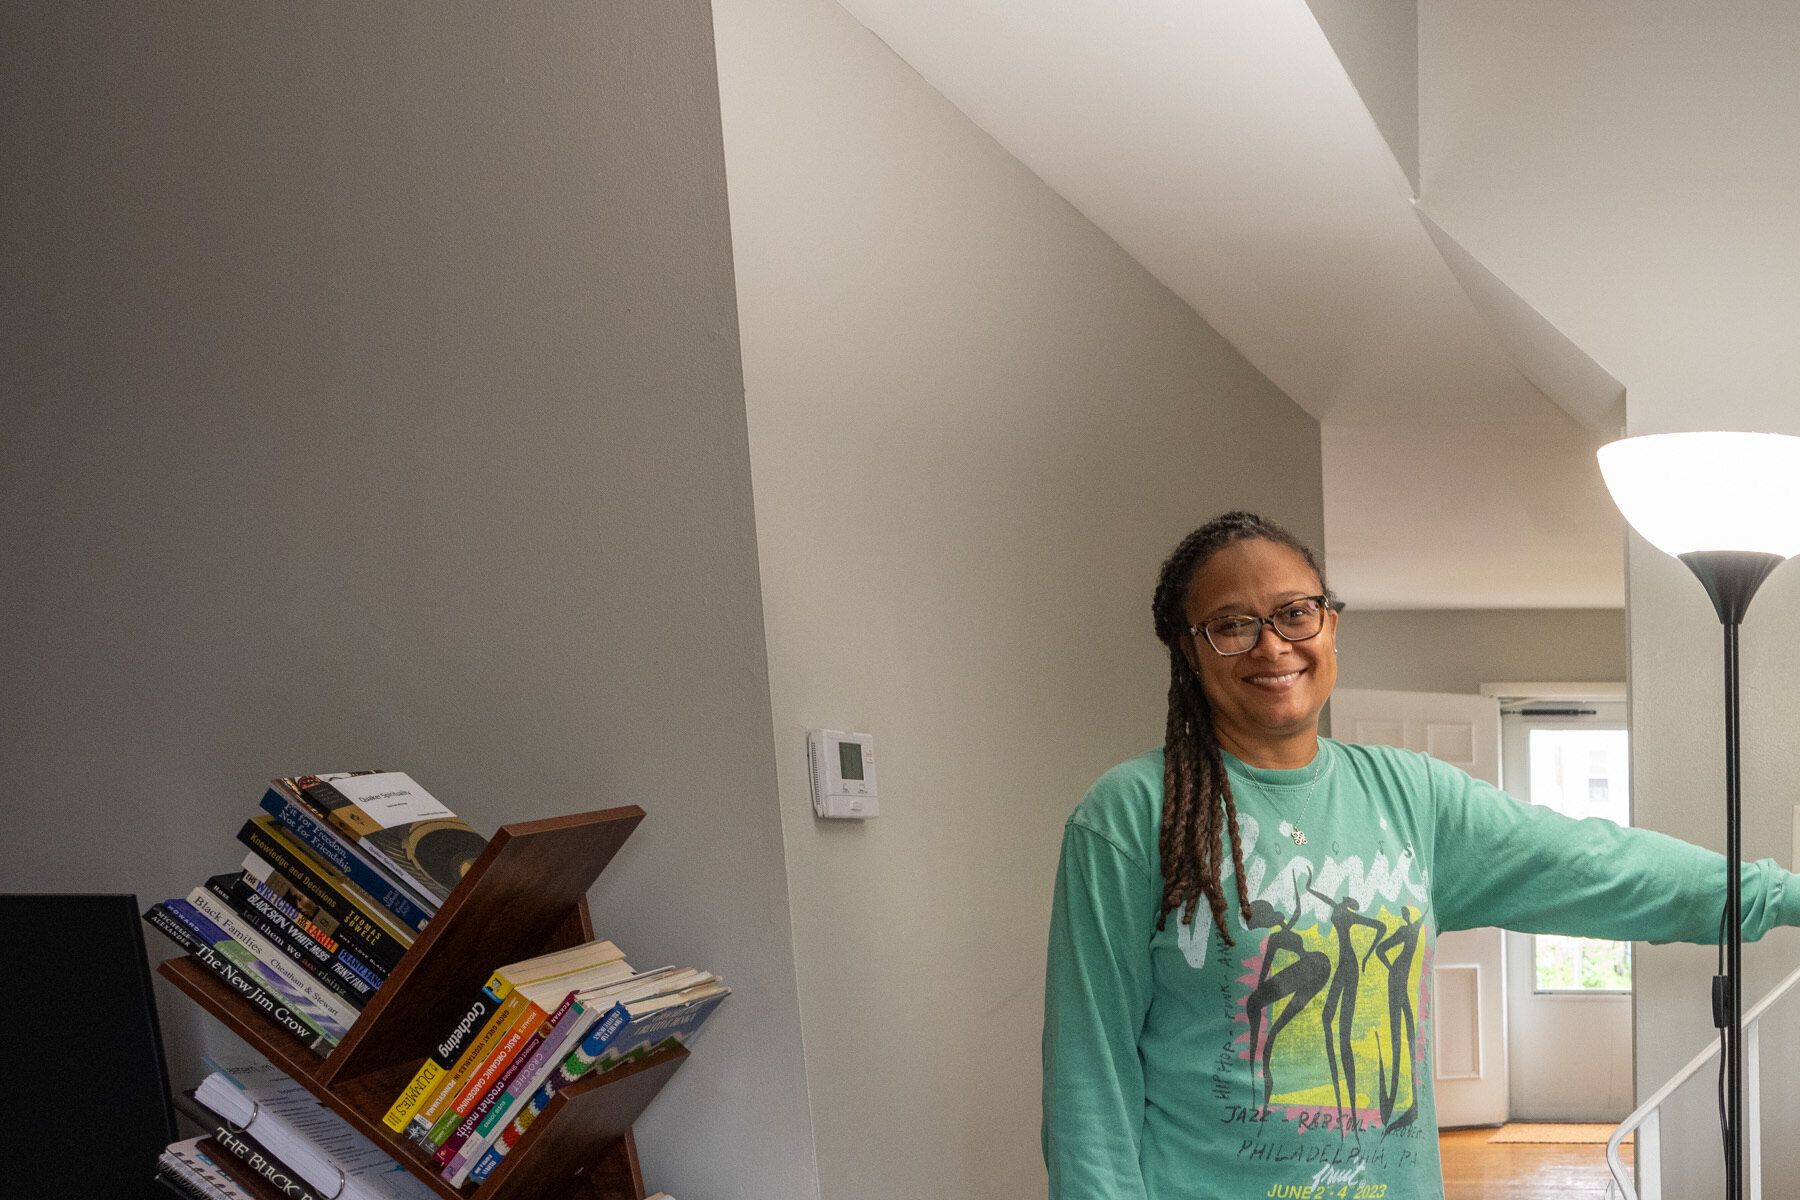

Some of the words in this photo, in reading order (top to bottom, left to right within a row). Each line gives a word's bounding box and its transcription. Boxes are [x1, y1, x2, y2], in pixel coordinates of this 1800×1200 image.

[359, 791, 385, 804] Quaker
[278, 809, 298, 827] Not
[295, 824, 312, 839] for
[308, 836, 354, 874] Friendship
[283, 802, 299, 816] Fit
[297, 813, 313, 828] for
[311, 825, 350, 859] Freedom,
[247, 833, 291, 869] Knowledge
[287, 865, 304, 880] and
[300, 875, 339, 908] Decisions
[150, 914, 191, 947] ALEXANDER
[156, 910, 192, 939] MICHELLE
[166, 904, 200, 932] HOWARD
[193, 895, 224, 922] Black
[220, 918, 265, 955] Families
[246, 891, 272, 915] BLACK
[285, 924, 314, 950] WHITE
[308, 943, 331, 963] MASKS
[341, 915, 378, 946] SOWELL
[346, 909, 383, 940] THOMAS
[258, 922, 287, 946] them
[284, 944, 302, 960] we
[315, 968, 348, 997] rising
[338, 950, 366, 974] FRANTZ
[363, 969, 384, 988] FANO
[194, 942, 225, 971] The
[219, 963, 254, 994] New
[246, 985, 278, 1014] Jim
[272, 1004, 312, 1039] Crow
[268, 957, 306, 989] Cheatham
[303, 985, 313, 995] &
[311, 991, 340, 1016] Stewart
[330, 961, 354, 982] FRANTZ
[348, 975, 370, 995] FANON
[494, 1008, 509, 1026] GROW
[549, 999, 570, 1025] ECKMAN
[1219, 983, 1235, 1019] FUNK
[435, 997, 488, 1061] Crocheting
[482, 1024, 498, 1043] GREAT
[517, 1010, 537, 1034] RODALE'S
[457, 1040, 485, 1075] VEGETABLES
[502, 1031, 521, 1053] BASIC
[521, 1036, 539, 1058] Connect
[1217, 1042, 1234, 1071] HOP
[452, 1072, 460, 1080] IN
[481, 1048, 508, 1080] ORGANIC
[501, 1063, 518, 1083] Shapes
[514, 1055, 524, 1066] the
[393, 1066, 435, 1117] DUMMIES
[424, 1078, 456, 1118] PENNSYLVANIA
[455, 1075, 487, 1115] GARDENING
[476, 1079, 506, 1115] crochet
[1212, 1075, 1230, 1099] HIP
[454, 1109, 482, 1141] motifs
[482, 1112, 497, 1129] JOHNS
[1220, 1105, 1271, 1124] JAZZ
[1298, 1111, 1334, 1131] R&B
[1335, 1113, 1367, 1134] SOUL
[216, 1130, 248, 1159] THE
[249, 1152, 300, 1196] BLACK
[1267, 1184, 1311, 1199] JUNE
[1313, 1184, 1327, 1199] 2
[1336, 1184, 1349, 1199] 4
[1353, 1184, 1387, 1199] 2023
